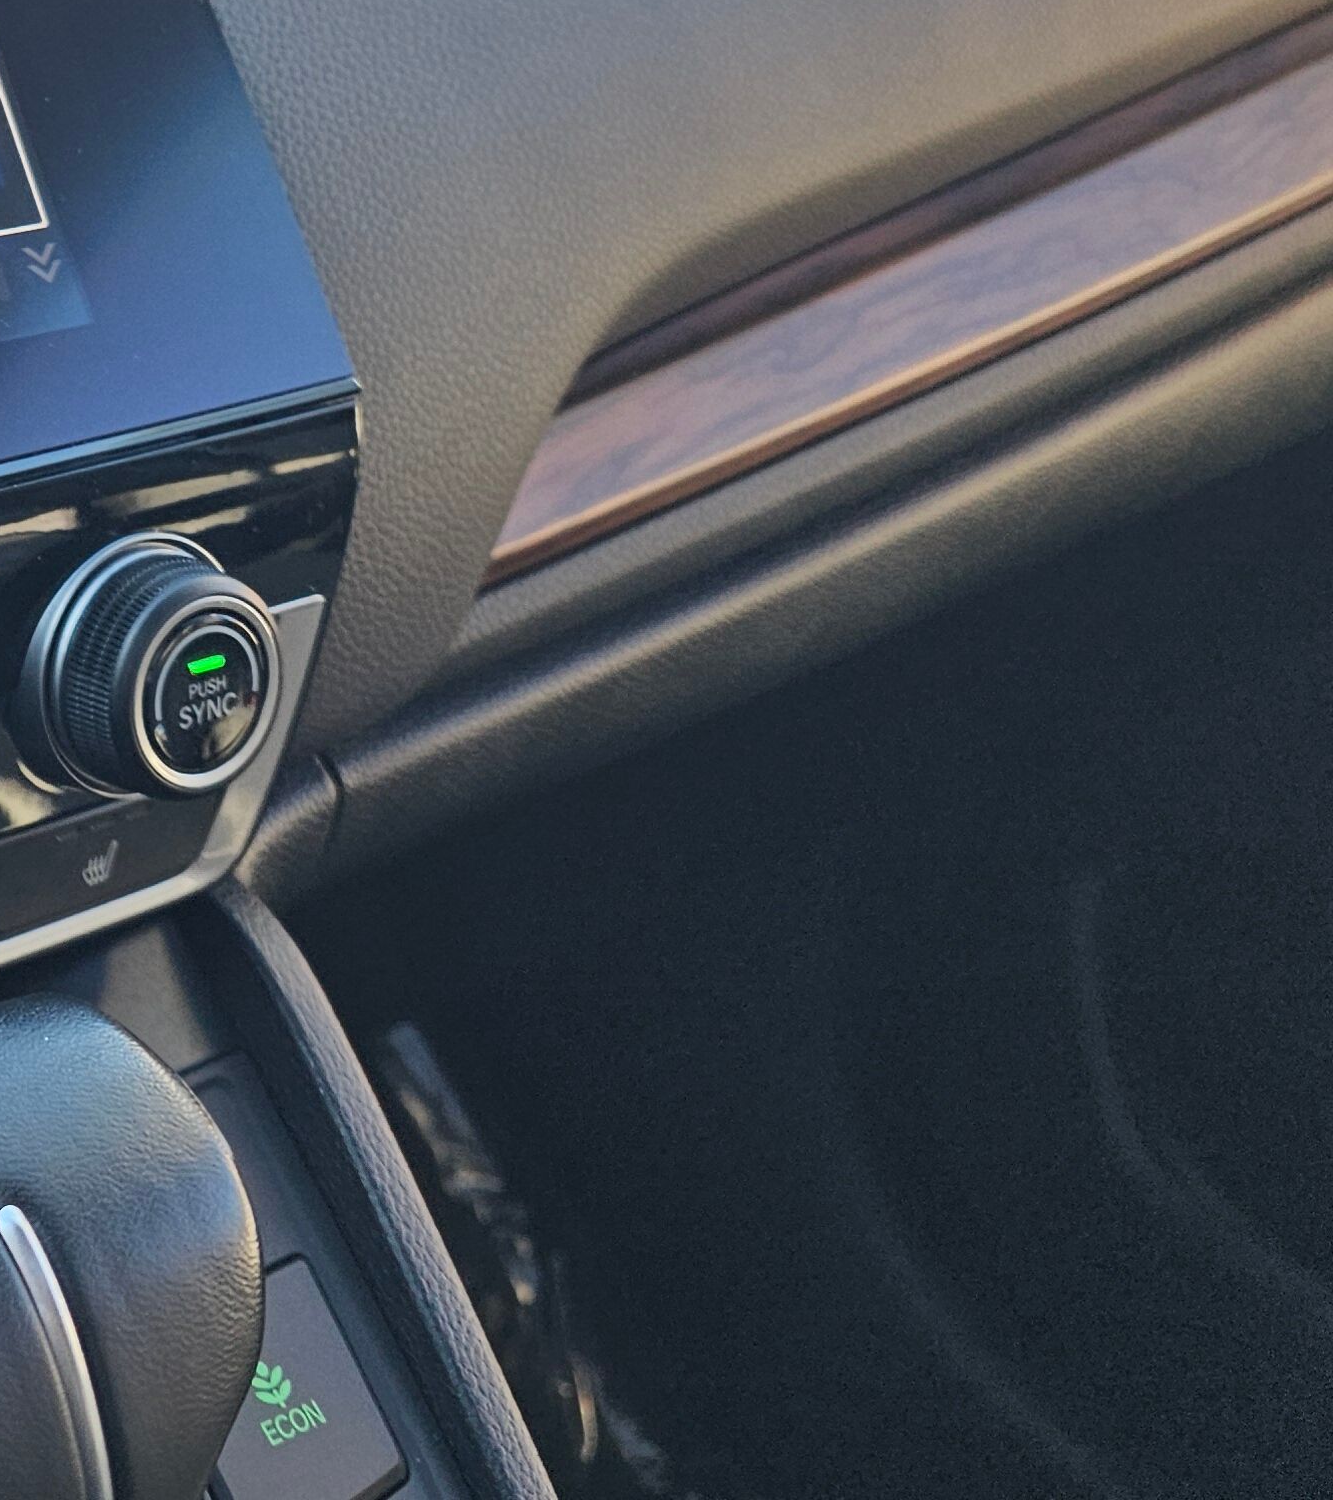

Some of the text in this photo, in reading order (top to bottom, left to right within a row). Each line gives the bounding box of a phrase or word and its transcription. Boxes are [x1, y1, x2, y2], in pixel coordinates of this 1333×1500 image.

[188, 674, 228, 700] PUSH
[179, 691, 239, 730] SYNC
[259, 1399, 327, 1446] ECON
